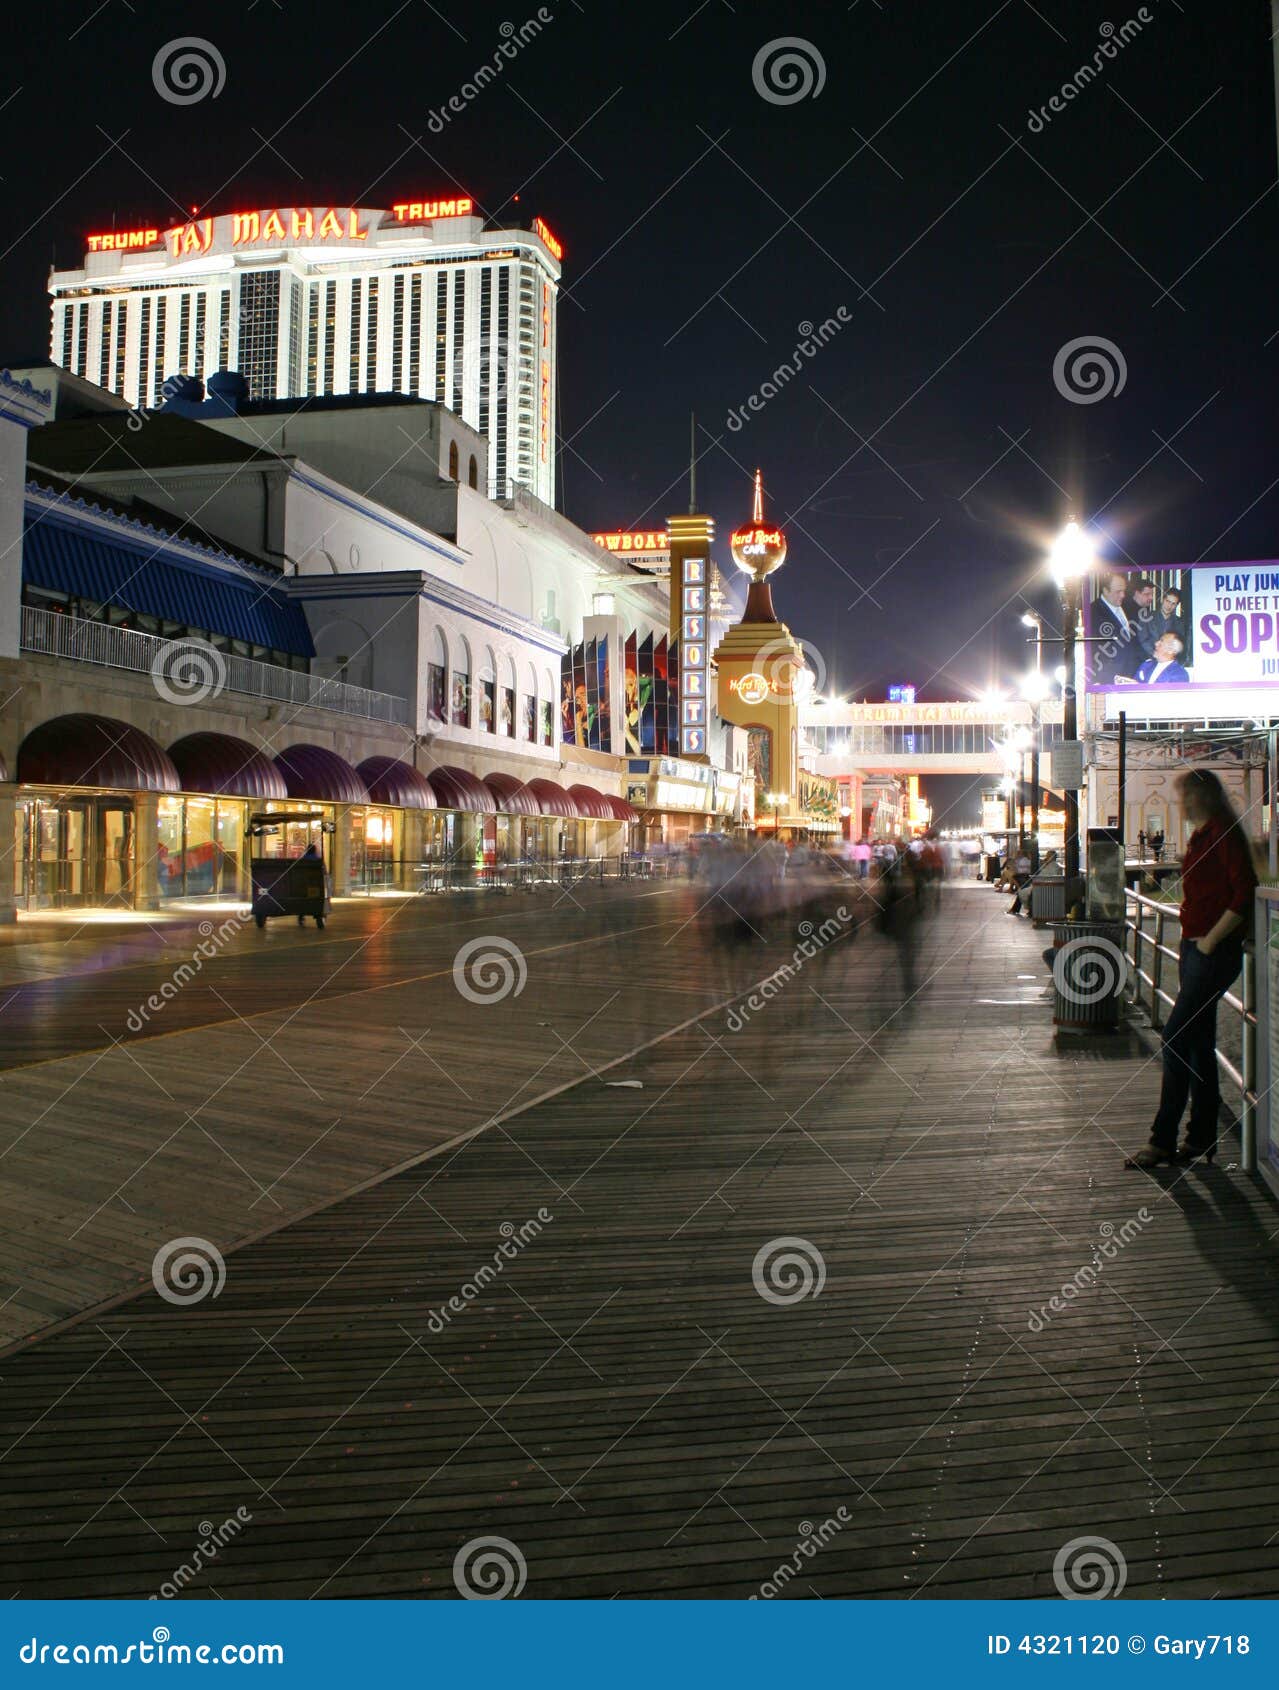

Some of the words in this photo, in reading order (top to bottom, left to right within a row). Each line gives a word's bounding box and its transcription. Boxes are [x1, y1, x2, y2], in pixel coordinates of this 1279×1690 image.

[393, 198, 472, 221] TRUMP
[88, 229, 158, 251] TRUMP
[169, 217, 214, 258] TAJ
[231, 206, 369, 247] MAHAL
[592, 533, 669, 550] OWBOAT
[1215, 574, 1250, 592] PLAY
[1215, 597, 1232, 611] TO
[1235, 595, 1268, 611] MEET
[1200, 612, 1279, 654] SOP
[1261, 658, 1279, 676] JU
[851, 707, 911, 721] TRUMP
